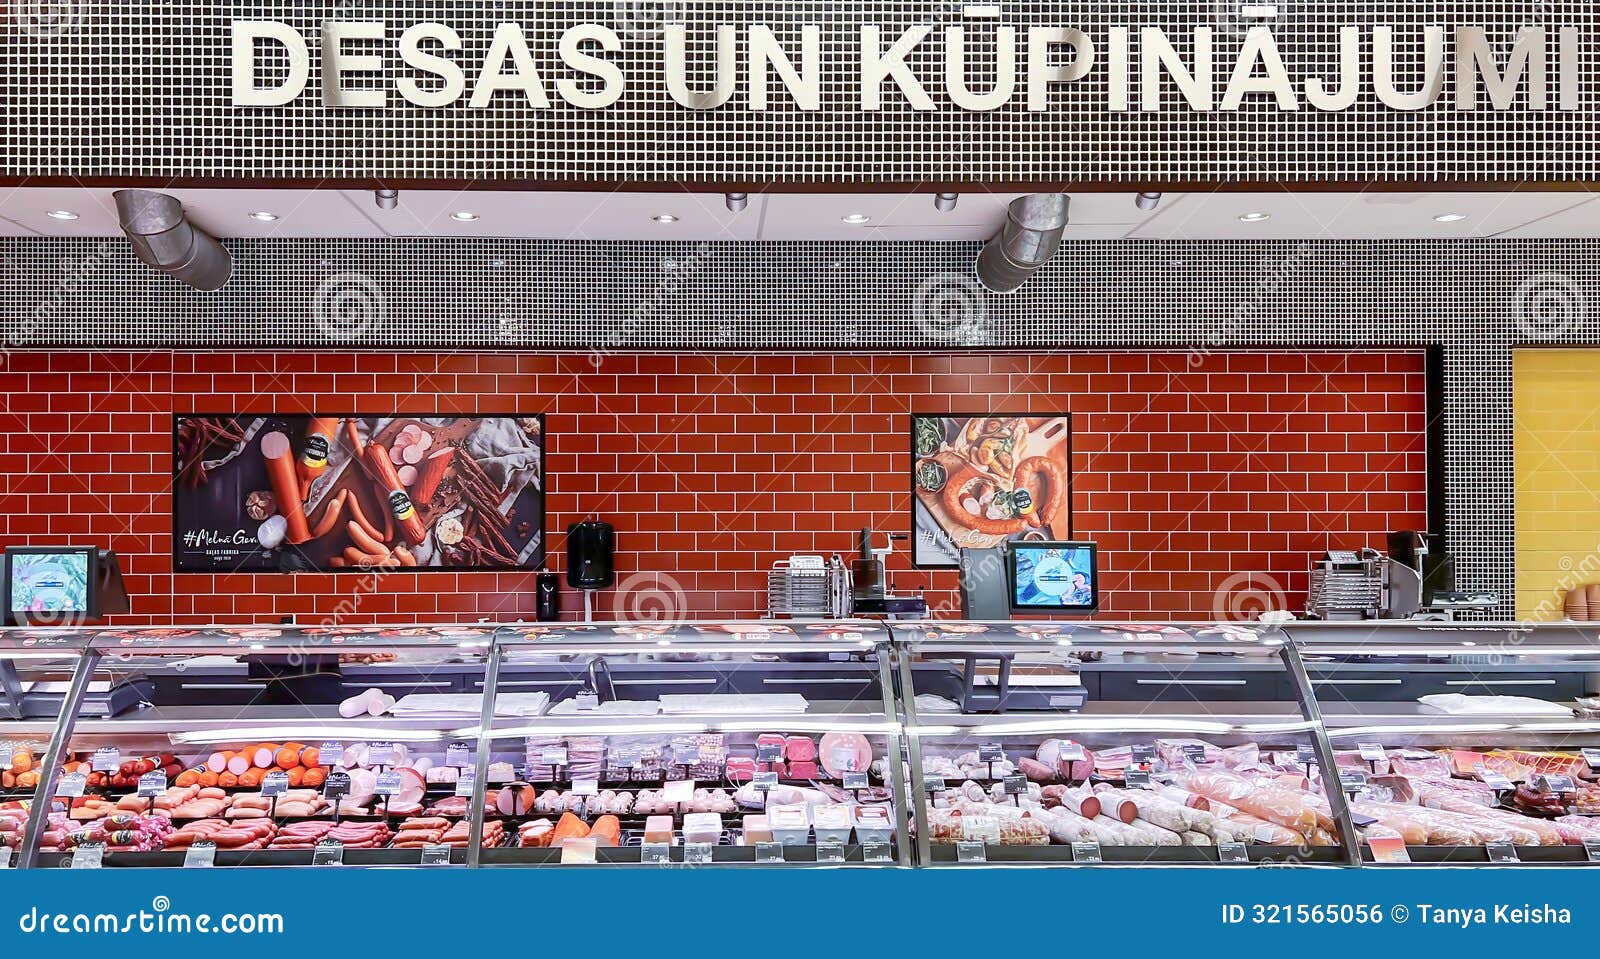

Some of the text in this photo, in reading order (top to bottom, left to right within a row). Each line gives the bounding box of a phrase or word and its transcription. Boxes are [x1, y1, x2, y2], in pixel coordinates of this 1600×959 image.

[231, 20, 625, 109] DESAS
[663, 23, 820, 111] UN
[860, 5, 1579, 111] KŪPINĀJUMI
